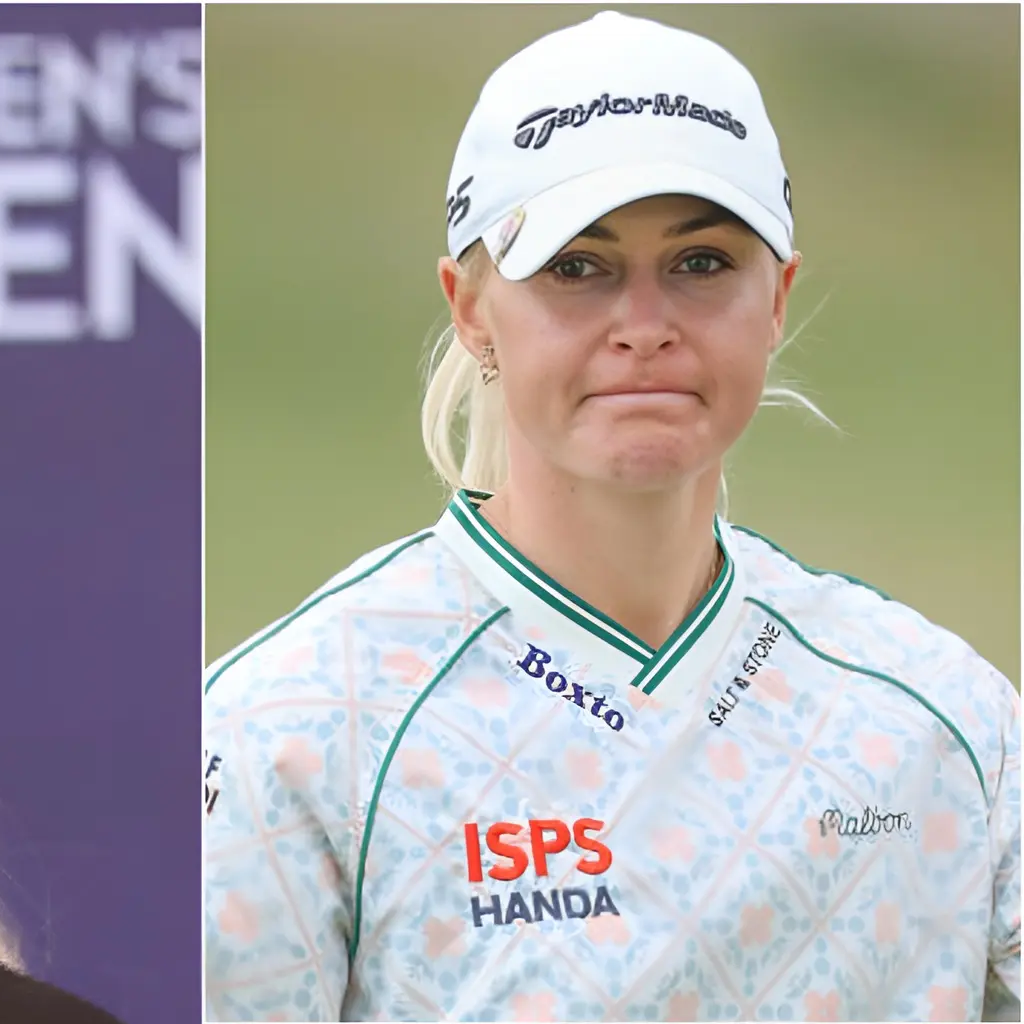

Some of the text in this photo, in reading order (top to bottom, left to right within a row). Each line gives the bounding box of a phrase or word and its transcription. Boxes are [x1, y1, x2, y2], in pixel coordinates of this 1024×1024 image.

[513, 93, 747, 150] TaylorMade
[516, 642, 624, 732] Boxto
[708, 686, 740, 727] SALT
[742, 621, 781, 676] STONE
[464, 817, 613, 883] ISPS
[470, 885, 621, 928] HANDA
